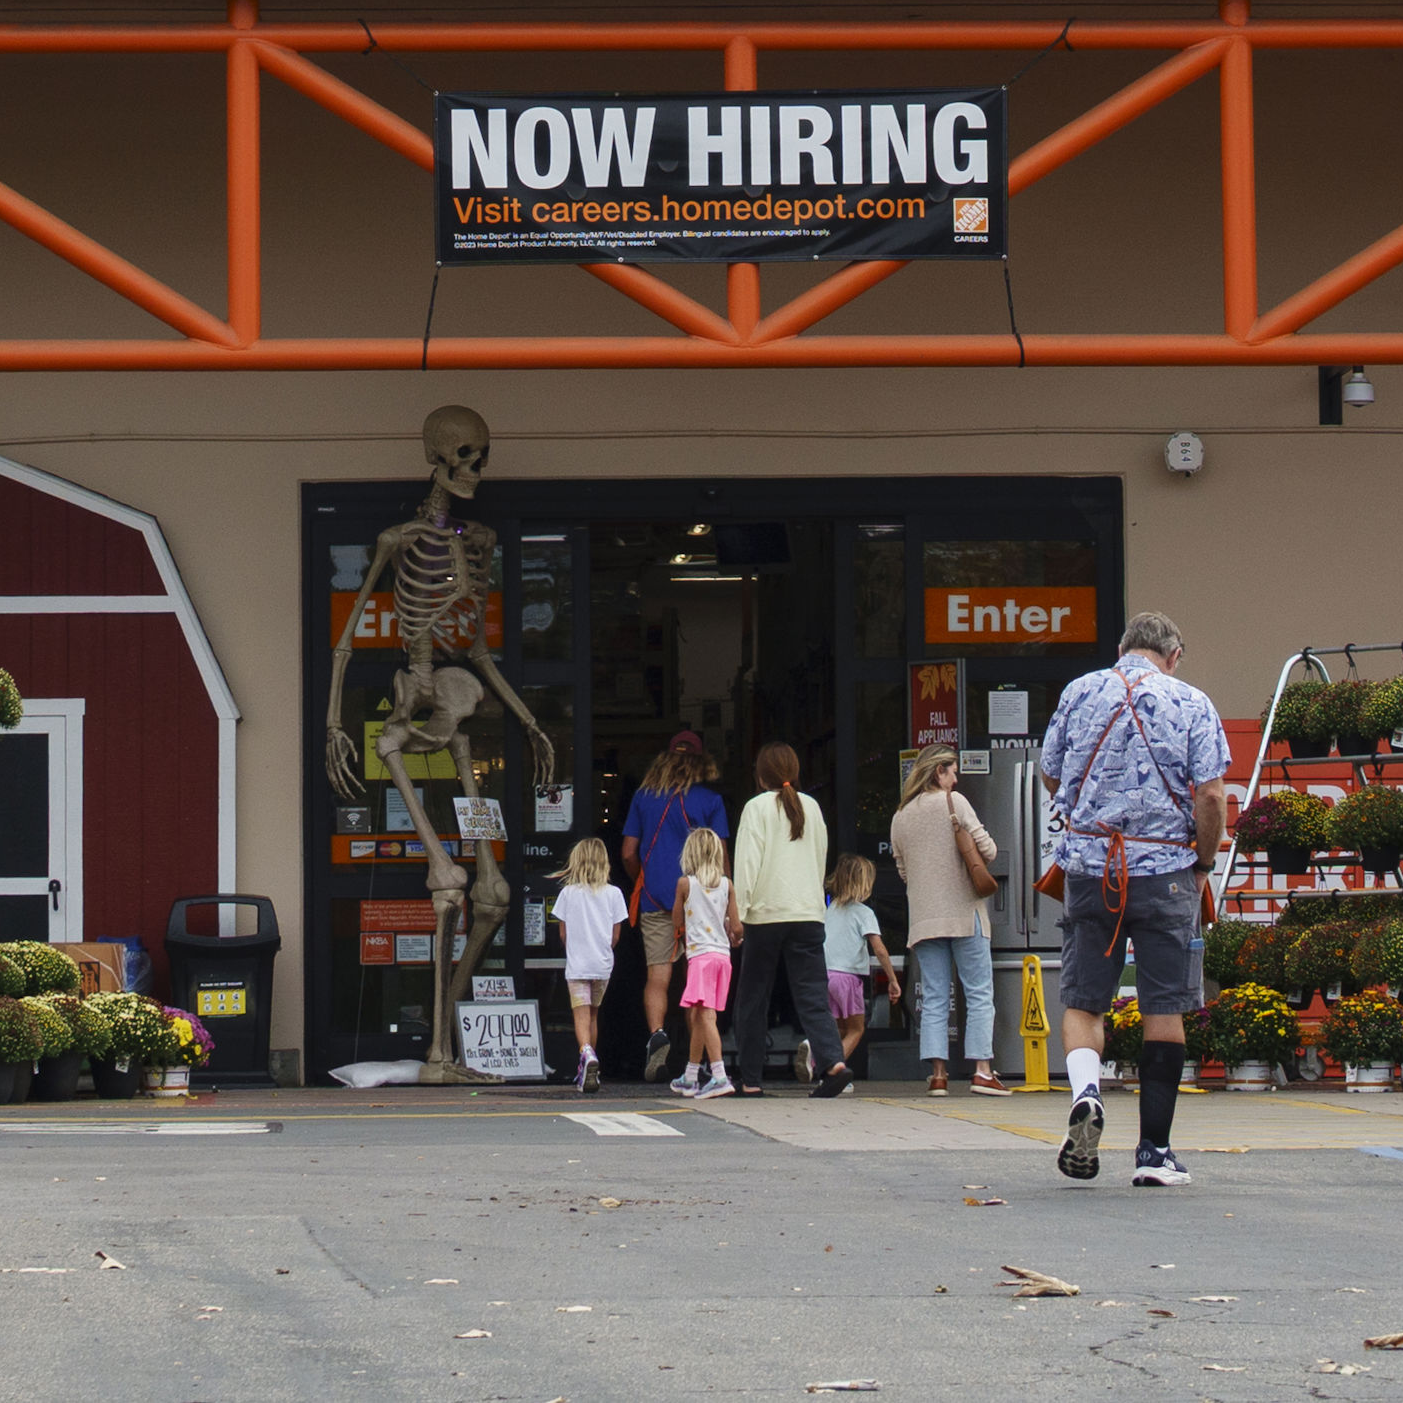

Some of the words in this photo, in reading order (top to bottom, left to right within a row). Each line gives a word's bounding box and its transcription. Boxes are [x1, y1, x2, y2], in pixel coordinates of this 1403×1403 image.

[450, 106, 657, 190] NOW
[687, 101, 989, 187] HIRING
[453, 196, 522, 224] Visit
[532, 194, 925, 225] careers.homedepot.com
[530, 231, 549, 240] Equal
[683, 230, 711, 238] Bilingual
[762, 229, 802, 237] encouraged
[953, 235, 989, 243] CAREERS
[498, 241, 519, 249] Depot
[520, 240, 547, 248] Product
[607, 239, 626, 247] rights
[948, 594, 1071, 633] Enter
[929, 712, 948, 726] FALL
[918, 728, 958, 744] APPLIANCE
